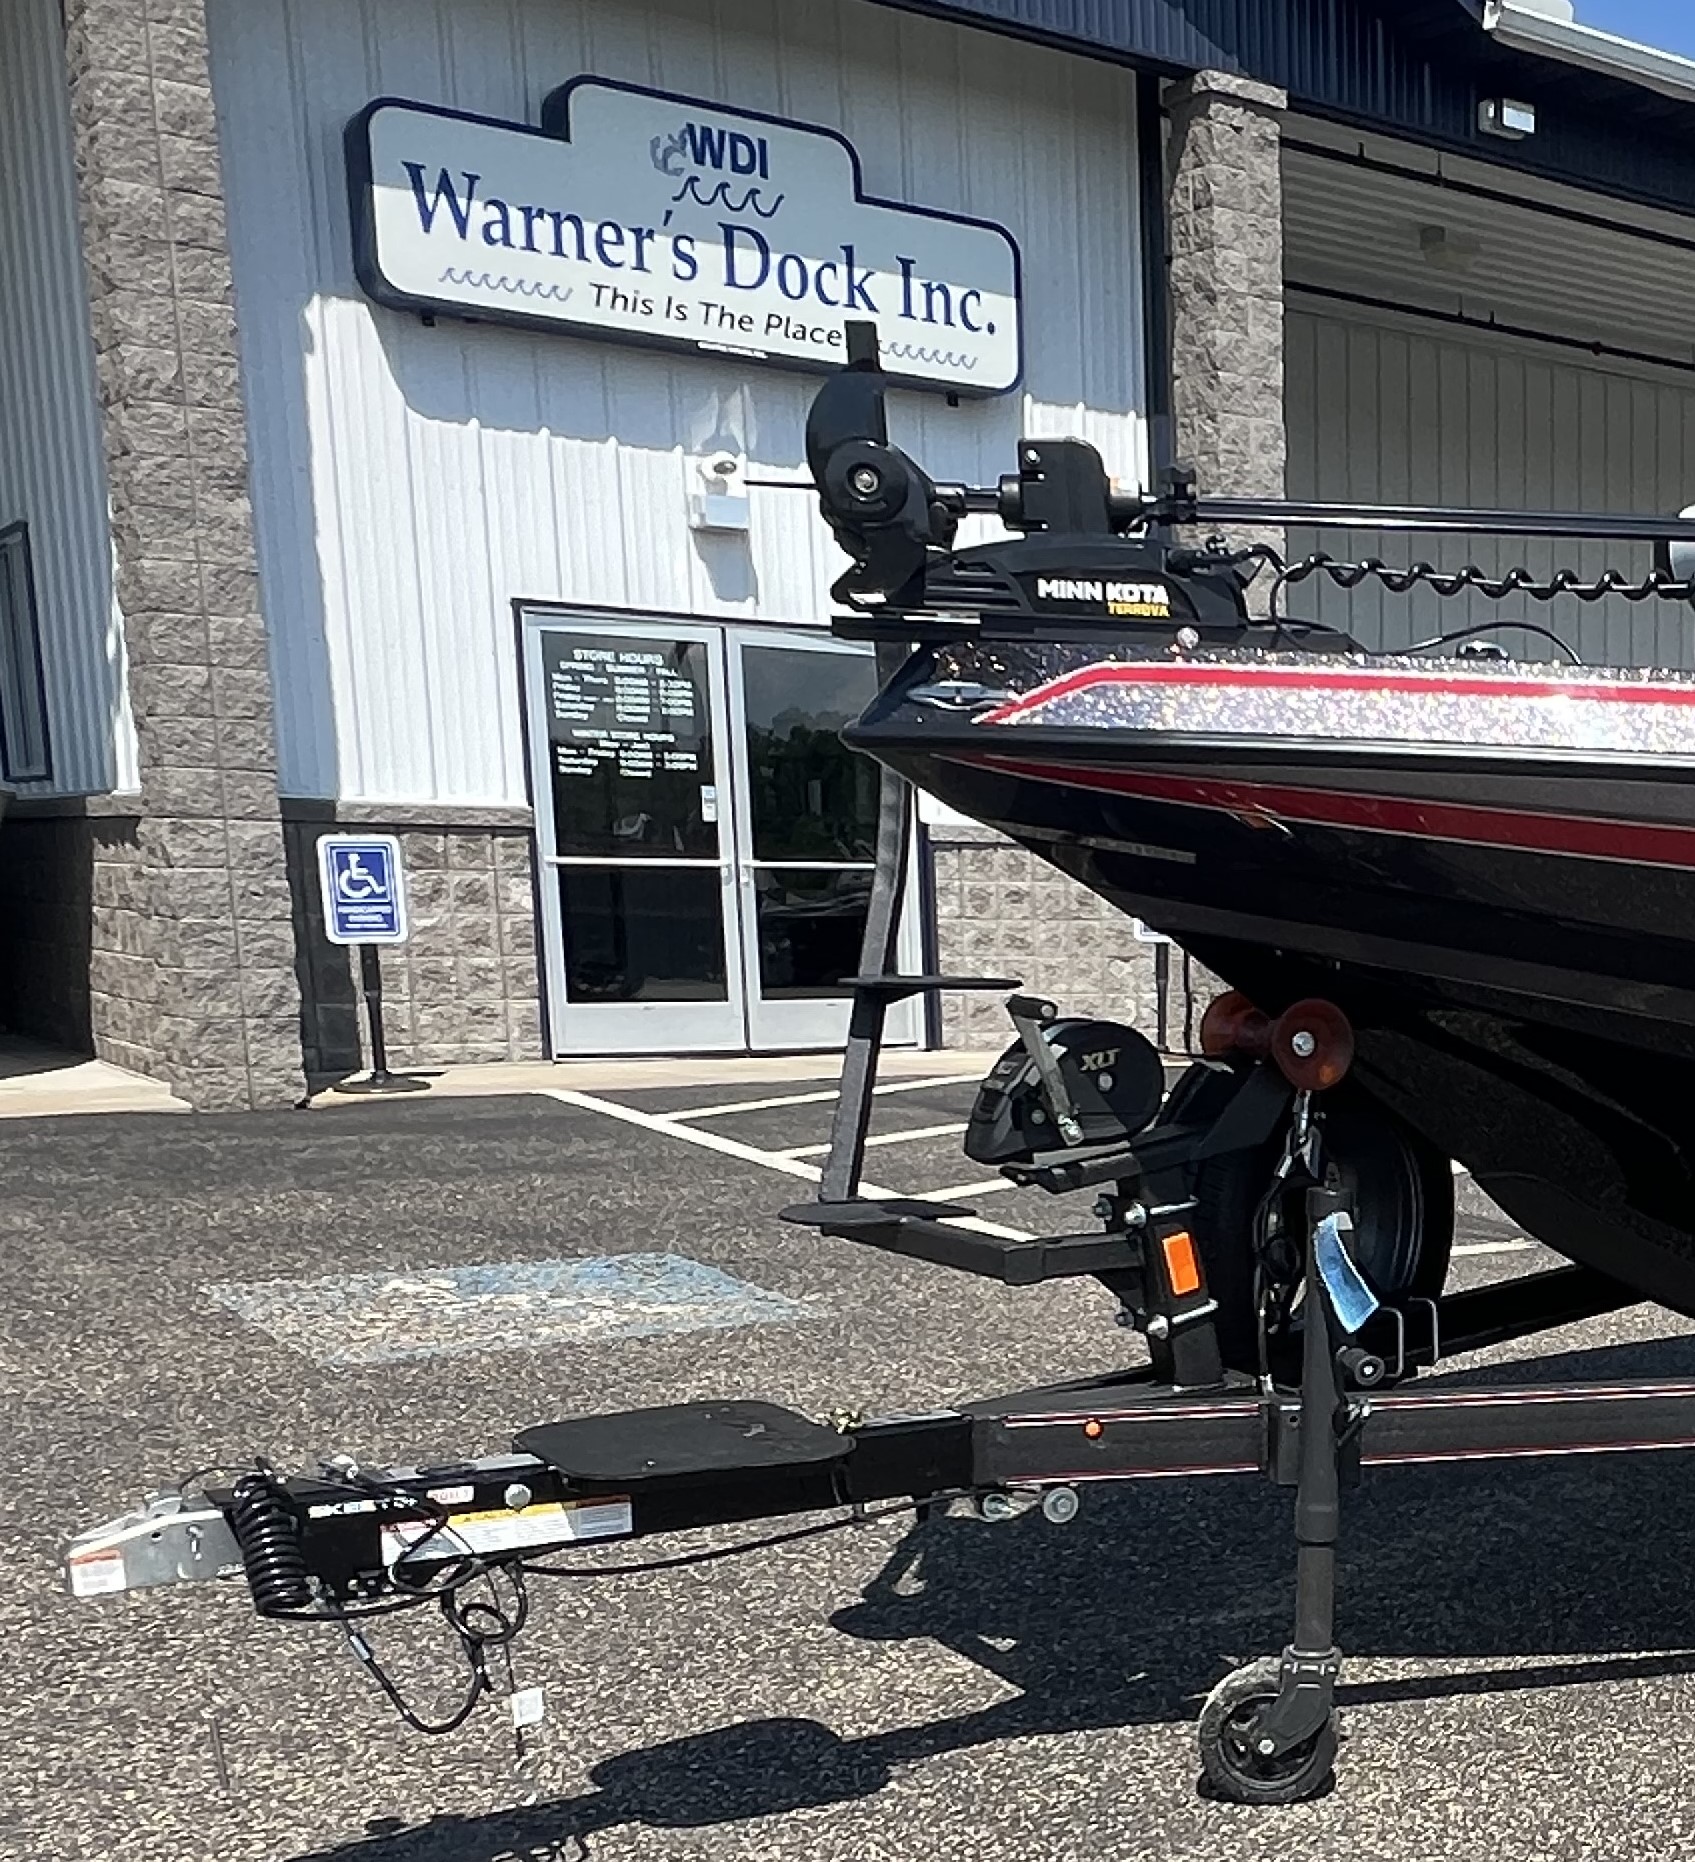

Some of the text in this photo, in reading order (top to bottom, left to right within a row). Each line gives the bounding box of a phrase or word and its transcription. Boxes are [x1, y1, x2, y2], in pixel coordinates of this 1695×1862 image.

[686, 122, 769, 180] WDI
[401, 159, 997, 335] Warner's Dock Inc.
[589, 281, 843, 347] This Is The Place
[1037, 577, 1170, 605] MINN KOTA
[1079, 1047, 1122, 1071] XLT
